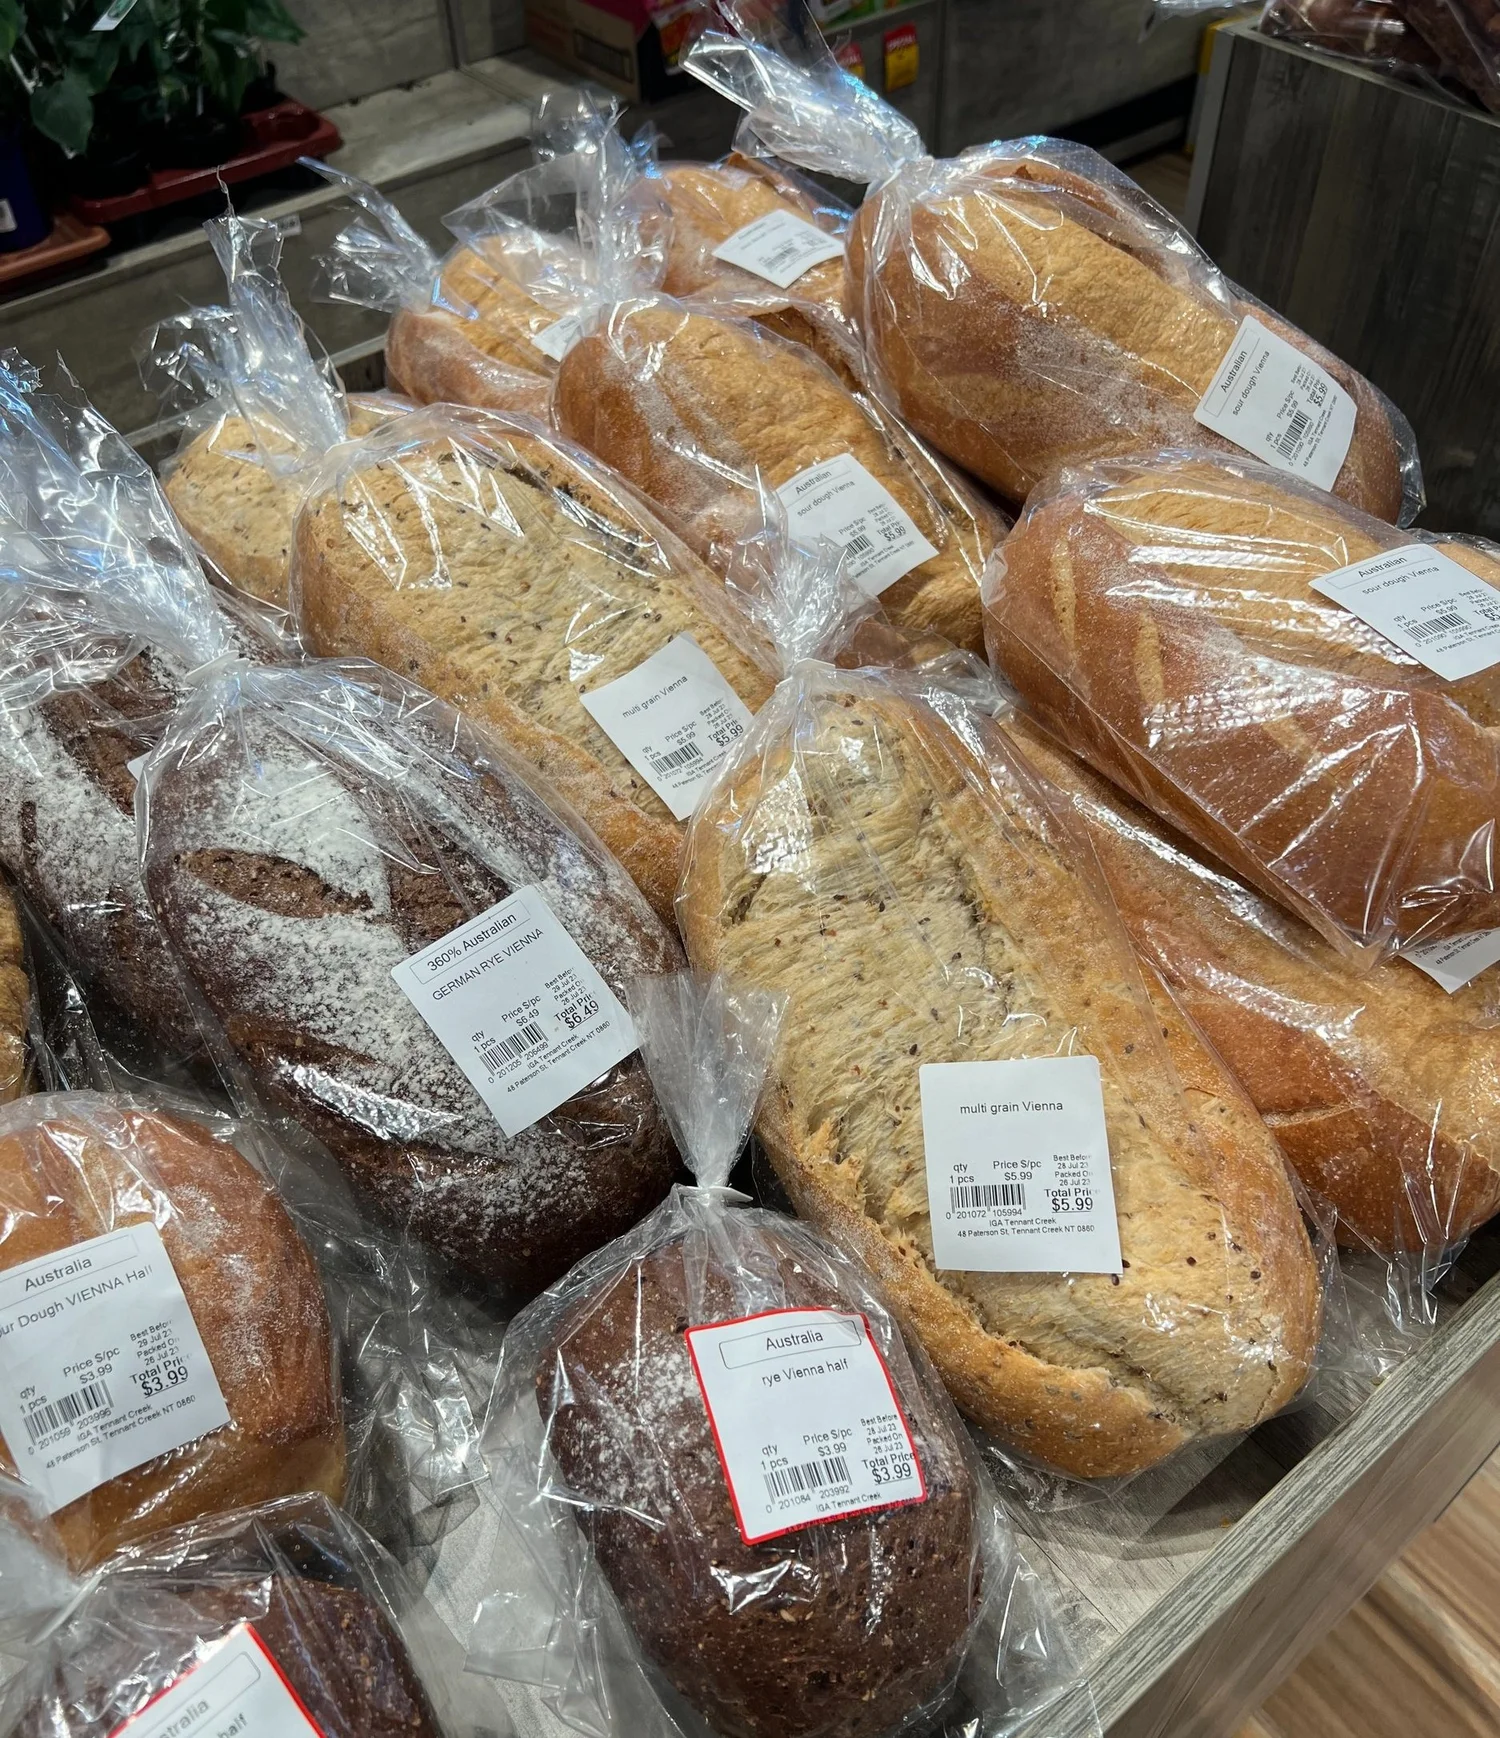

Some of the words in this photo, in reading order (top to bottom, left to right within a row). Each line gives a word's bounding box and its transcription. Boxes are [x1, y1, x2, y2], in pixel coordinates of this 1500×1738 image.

[1221, 351, 1247, 393] Australian
[1232, 399, 1244, 416] sour
[1242, 376, 1257, 399] dough
[1253, 351, 1270, 374] Vienna
[1313, 383, 1328, 407] $5.99
[1276, 403, 1288, 419] Price
[1286, 398, 1298, 418] $5.99
[1266, 432, 1274, 442] qty
[1273, 433, 1282, 446] pcs
[796, 471, 832, 495] Australian
[797, 504, 812, 516] sour
[813, 491, 834, 506] dough
[832, 481, 855, 493] Vienna
[884, 526, 906, 542] $5.99
[1358, 558, 1407, 578] Australian
[1362, 585, 1382, 594] sour
[1382, 575, 1410, 587] dough
[1408, 567, 1439, 577] Vienna
[1420, 603, 1441, 612] Price
[622, 706, 641, 718] multi
[641, 694, 661, 710] grain
[660, 676, 688, 696] Vienna
[665, 730, 683, 742] Price
[676, 731, 696, 746] $5.99
[708, 727, 726, 741] Total
[716, 724, 744, 746] $5.99
[427, 947, 462, 971] 360%
[463, 914, 517, 951] Australian
[432, 966, 481, 1000] GERMAN
[480, 953, 504, 972] RYE
[502, 928, 544, 957] VIENNA
[544, 978, 559, 989] Best
[554, 984, 575, 1001] Packed
[501, 1007, 523, 1022] Price
[522, 996, 541, 1010] $/pc
[516, 1009, 540, 1027] $6.49
[554, 1003, 577, 1021] Total
[564, 1000, 599, 1028] $6.49
[472, 1030, 485, 1042] qty
[480, 1037, 496, 1051] pcs
[496, 1059, 522, 1079] 201205
[524, 1042, 549, 1060] 206499
[514, 1070, 540, 1088] Paterson
[547, 1049, 571, 1065] Tennant
[570, 1038, 587, 1051] Creek
[586, 1030, 595, 1040] NT
[527, 1060, 539, 1070] IGA
[538, 1045, 562, 1061] Tennant
[561, 1034, 579, 1047] Creek
[960, 1103, 987, 1114] multi
[990, 1103, 1019, 1115] grain
[1022, 1101, 1063, 1111] Vienna
[953, 1163, 968, 1173] qty
[993, 1161, 1018, 1169] Price
[1020, 1160, 1041, 1170] $/pc
[950, 1175, 954, 1184] 1
[958, 1176, 974, 1186] pcs
[1004, 1171, 1032, 1181] $5.99
[1044, 1188, 1071, 1198] Total
[956, 1210, 986, 1219] 201072
[993, 1208, 1022, 1217] 105994
[1052, 1198, 1093, 1211] $5.99
[25, 1259, 92, 1292] Australia
[18, 1302, 64, 1328] Dough
[65, 1277, 124, 1306] VIENNA
[130, 1329, 149, 1341] Best
[767, 1330, 823, 1351] Australia
[137, 1341, 167, 1358] Packed
[63, 1359, 93, 1377] Price
[94, 1348, 120, 1363] $/pc
[79, 1363, 113, 1384] $3.99
[130, 1364, 161, 1384] Total
[141, 1364, 188, 1398] $3.99
[762, 1374, 781, 1387] rye
[782, 1365, 825, 1380] Vienna
[826, 1358, 848, 1372] half
[20, 1386, 35, 1400] qty
[20, 1405, 26, 1414] 1
[28, 1396, 47, 1413] pcs
[77, 1430, 92, 1442] IGA
[93, 1414, 127, 1433] Tennant
[128, 1404, 152, 1418] Creek
[103, 1421, 137, 1440] Tennant
[137, 1410, 162, 1425] Creek
[162, 1403, 174, 1414] NT
[860, 1417, 876, 1426] Best
[876, 1414, 897, 1423] Before
[877, 1425, 887, 1434] Jul
[887, 1423, 897, 1432] 23
[28, 1446, 34, 1455] 0
[35, 1427, 71, 1450] 201059
[77, 1407, 112, 1430] 203996
[803, 1433, 830, 1445] Price
[830, 1428, 852, 1440] $/pc
[866, 1434, 892, 1444] Packed
[892, 1432, 903, 1440] On
[762, 1444, 777, 1457] qty
[818, 1442, 847, 1457] $3.99
[894, 1441, 903, 1450] 23
[761, 1461, 766, 1470] 1
[770, 1457, 788, 1471] pcs
[862, 1455, 889, 1469] Total
[872, 1462, 911, 1485] $3.99
[766, 1504, 772, 1514] 0
[778, 1493, 811, 1510] 201084
[819, 1485, 850, 1499] 203992
[816, 1503, 831, 1512] IGA
[831, 1496, 861, 1508] Tennant
[861, 1492, 881, 1502] Creek
